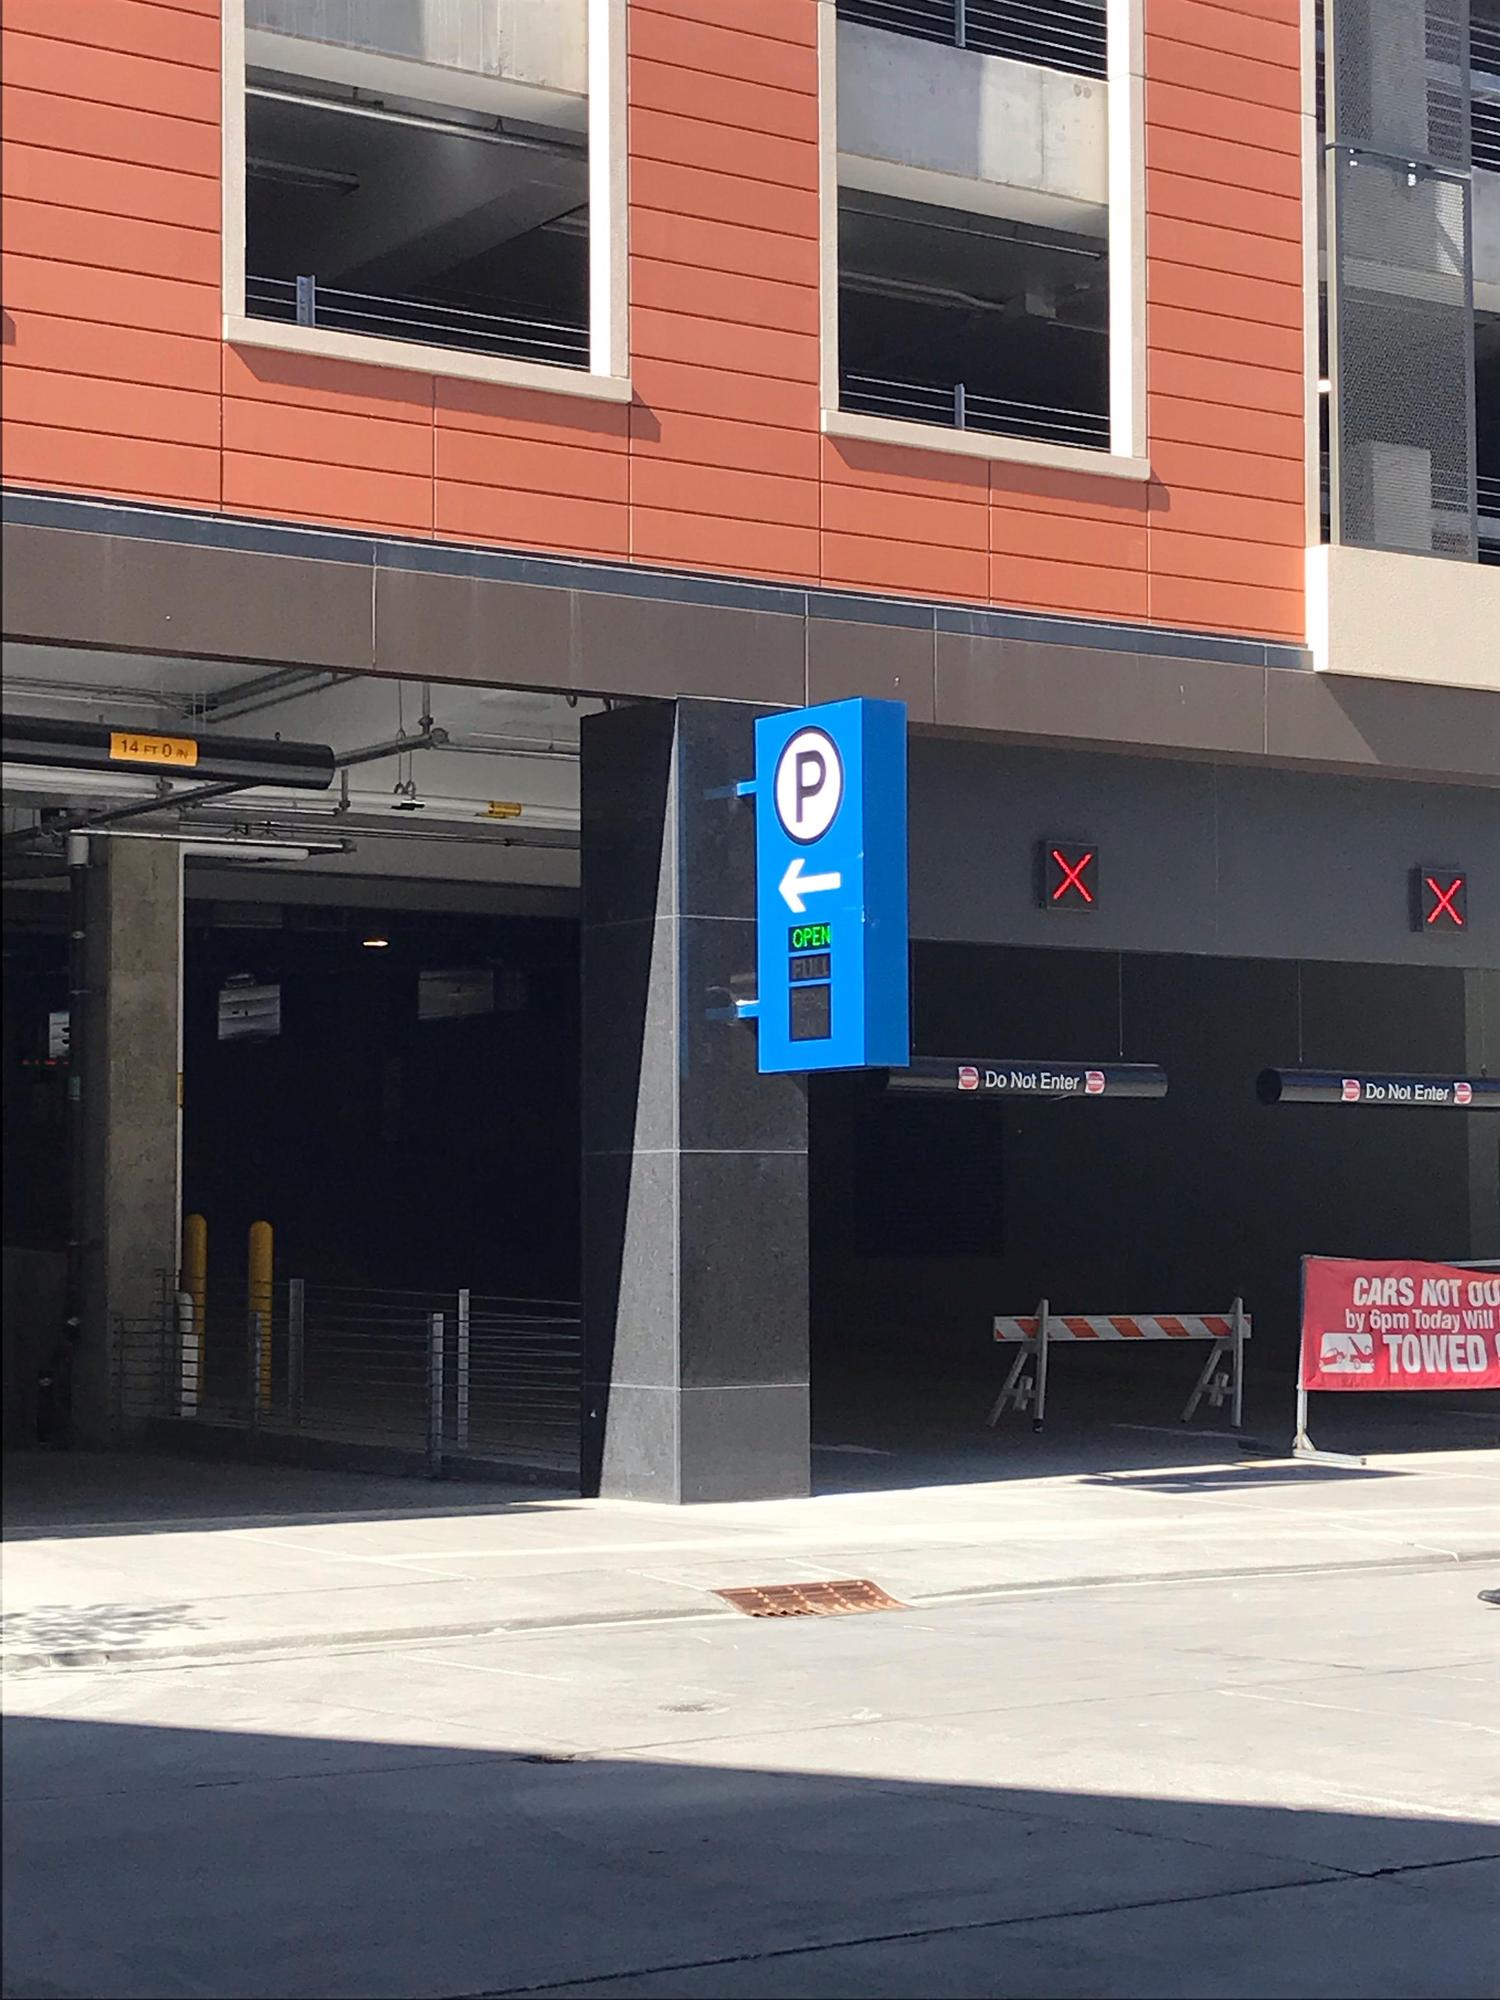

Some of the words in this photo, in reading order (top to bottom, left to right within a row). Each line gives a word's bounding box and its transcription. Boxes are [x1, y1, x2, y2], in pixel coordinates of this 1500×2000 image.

[121, 739, 139, 753] 14
[143, 744, 158, 755] FT
[795, 750, 827, 823] P
[792, 924, 831, 948] OPEN
[985, 1070, 1007, 1088] Do
[1010, 1071, 1036, 1089] Not
[1040, 1072, 1079, 1090] Enter
[1365, 1083, 1385, 1099] Do
[1388, 1083, 1411, 1100] Not
[1414, 1084, 1450, 1101] Enter
[1353, 1277, 1414, 1306] CARS
[1421, 1278, 1462, 1307] NOT
[1345, 1308, 1369, 1332] by
[1370, 1309, 1409, 1332] 6pm
[1412, 1309, 1460, 1333] Today
[1462, 1310, 1494, 1330] Will
[1382, 1334, 1488, 1373] TOWED
